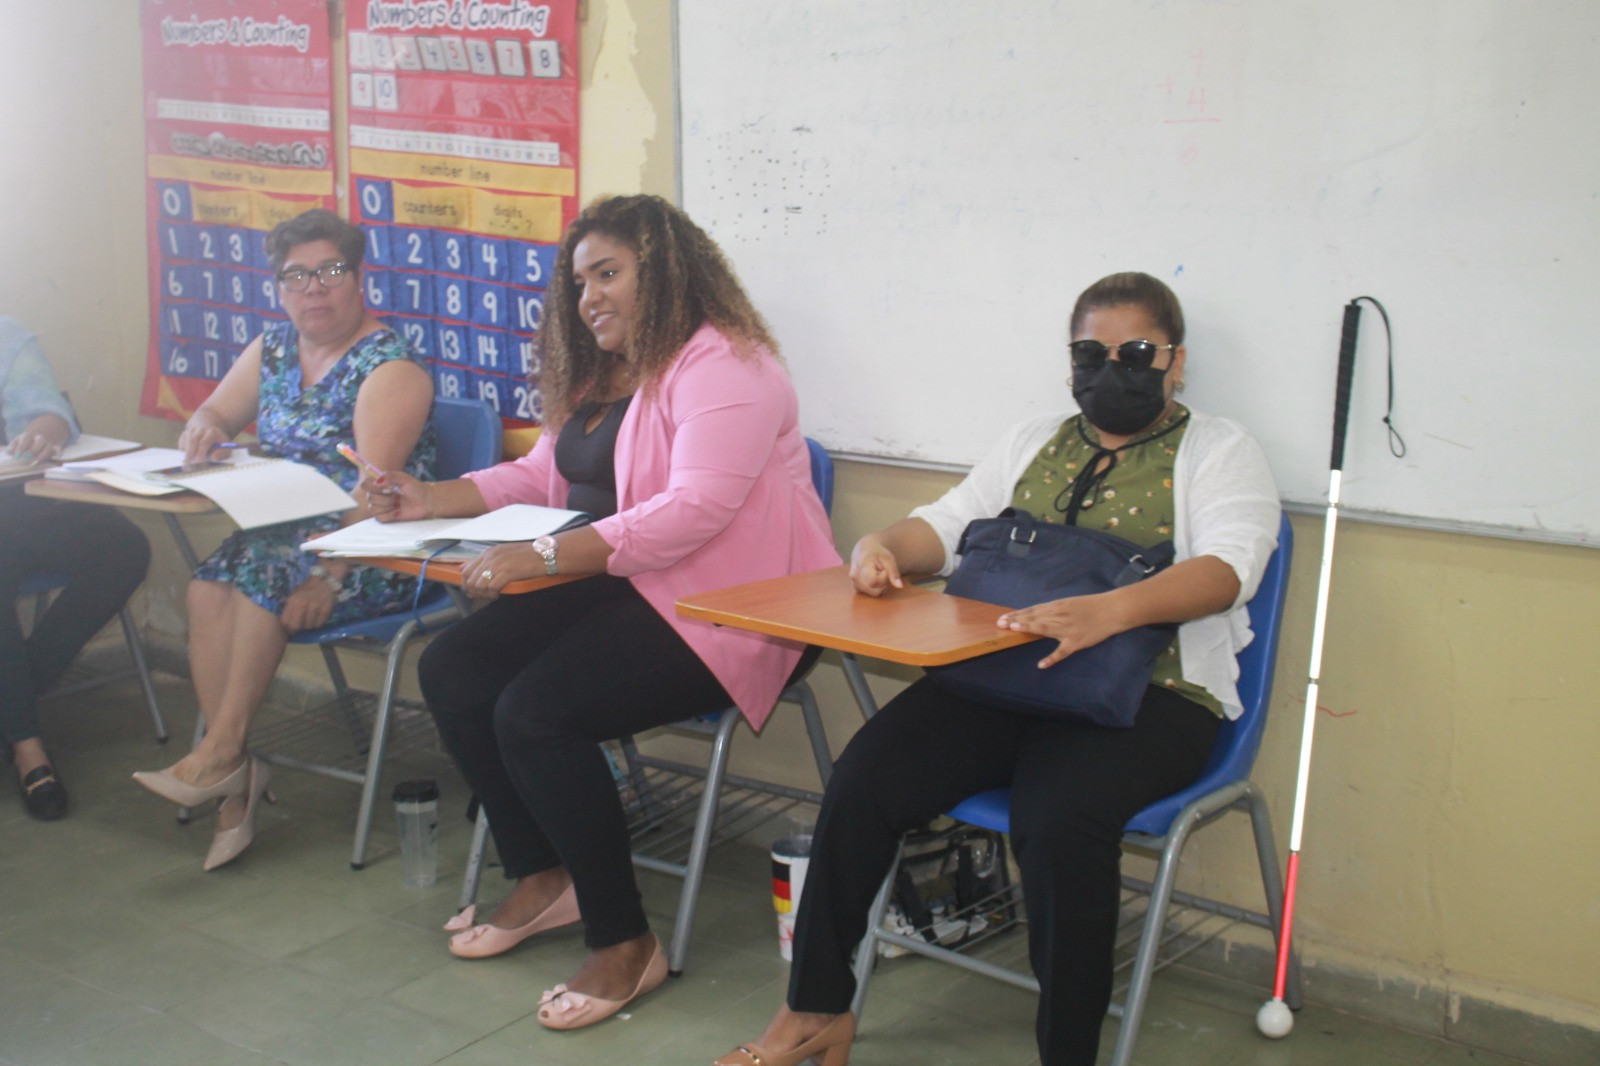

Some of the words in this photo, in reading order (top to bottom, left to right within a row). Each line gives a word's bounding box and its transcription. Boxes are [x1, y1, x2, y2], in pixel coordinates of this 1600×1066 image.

[162, 15, 226, 44] Numbers
[243, 16, 308, 51] Counting
[370, 0, 447, 27] Numbers
[450, 2, 463, 27] &
[467, 0, 548, 33] Counting
[475, 45, 486, 63] 6
[505, 48, 517, 68] 7
[539, 48, 551, 69] 8
[419, 162, 463, 178] number
[470, 163, 491, 182] line
[163, 188, 181, 216] 0
[362, 184, 382, 215] 0
[168, 228, 178, 255] 1
[199, 231, 215, 258] 2
[229, 233, 243, 262] 3
[369, 229, 380, 260] 1
[407, 232, 423, 264] 2
[446, 238, 461, 269] 3
[482, 243, 498, 276] 4
[525, 249, 542, 282] 5
[168, 270, 183, 297] 6
[203, 271, 213, 300] 7
[232, 276, 243, 303] 8
[262, 280, 276, 309] 9
[367, 276, 383, 306] 6
[406, 279, 421, 310] 7
[446, 284, 462, 315] 8
[482, 291, 498, 323] 9
[518, 296, 545, 330] 10
[203, 310, 220, 340] 12
[232, 315, 248, 344] 13
[403, 322, 426, 354] 12
[439, 329, 460, 361] 13
[477, 335, 498, 368] 14
[168, 347, 189, 374] 16
[203, 349, 218, 378] 17
[478, 381, 500, 412] 19
[514, 386, 545, 419] 20
